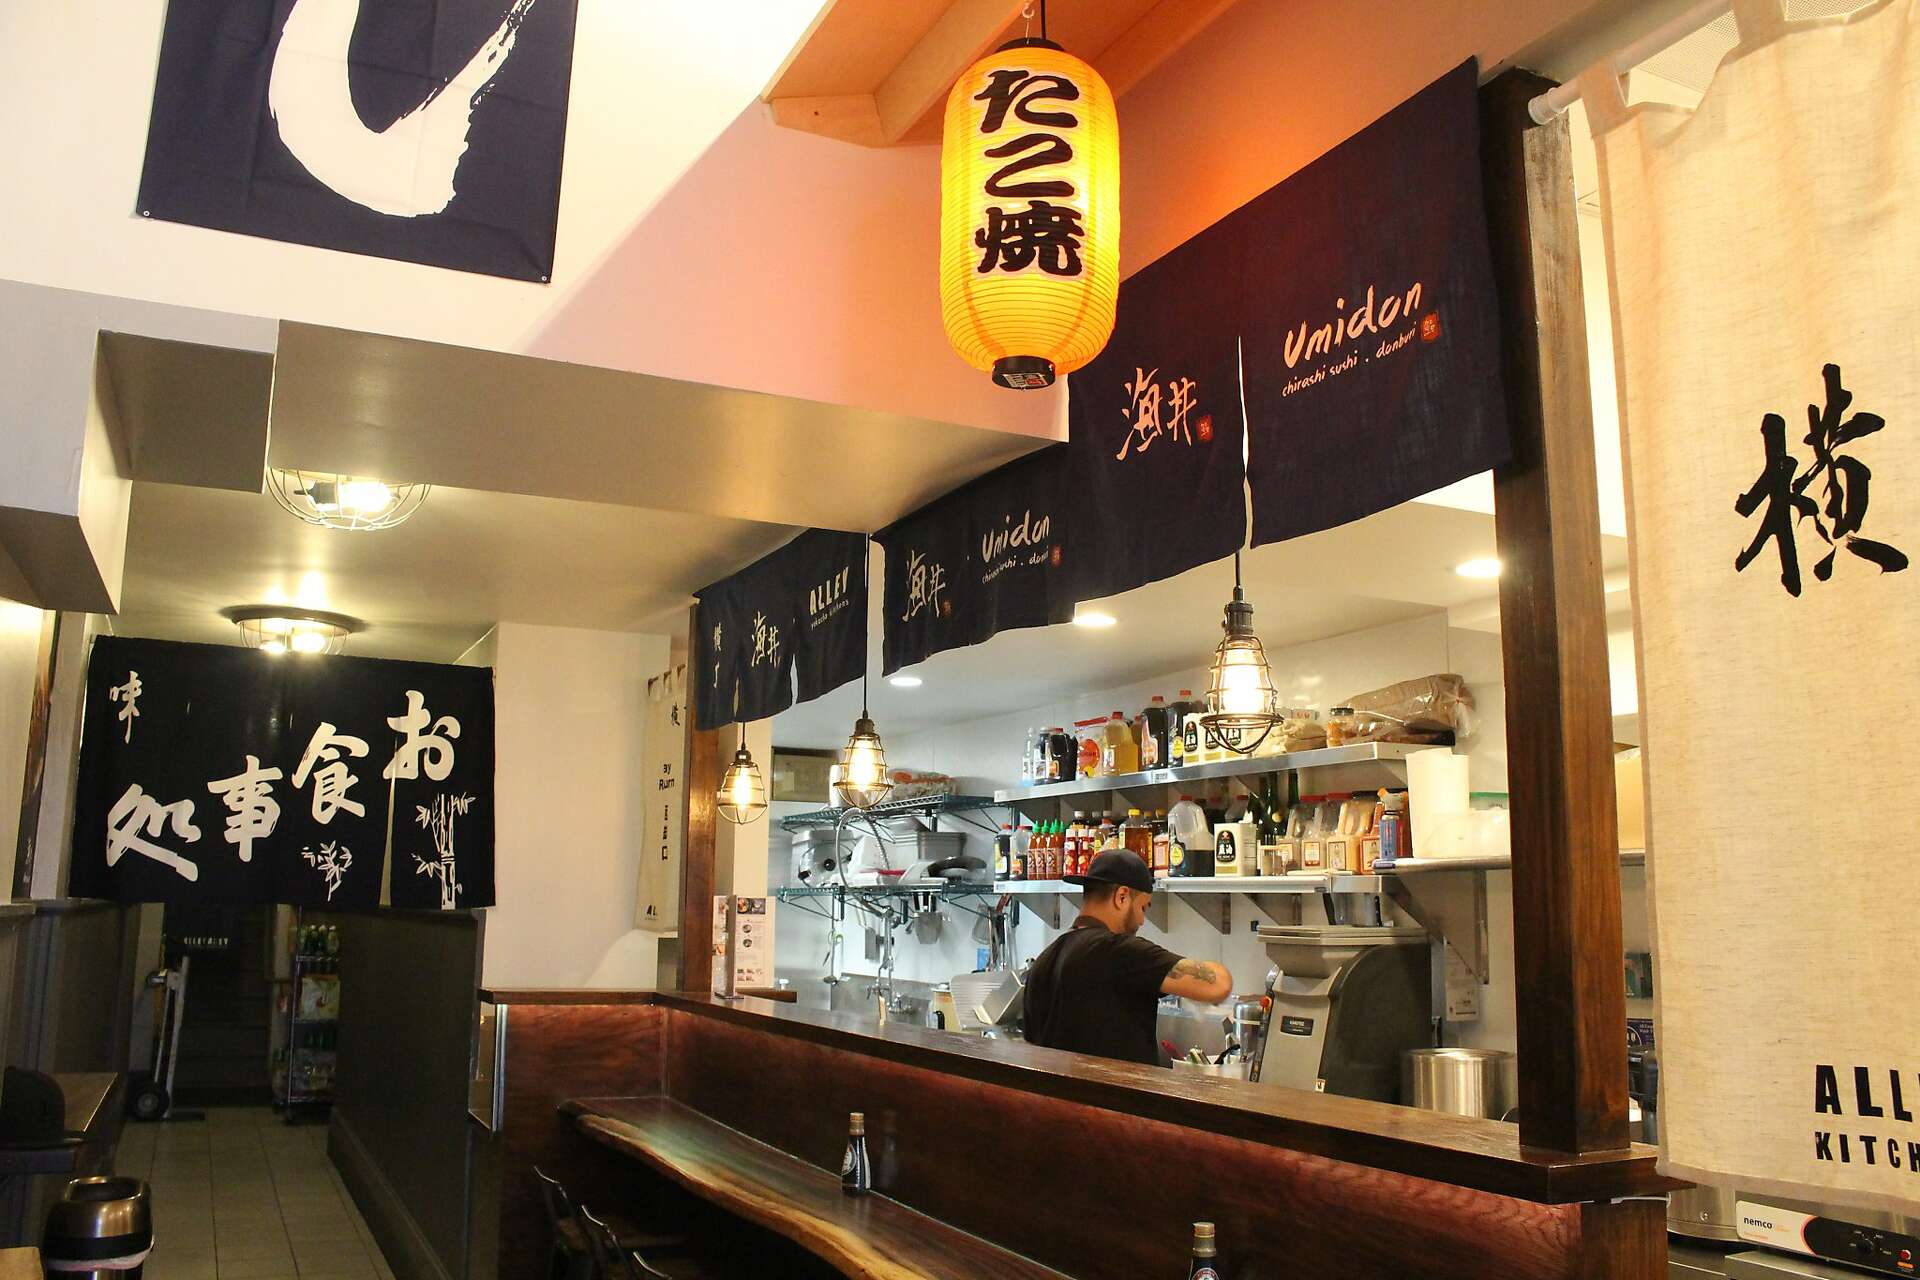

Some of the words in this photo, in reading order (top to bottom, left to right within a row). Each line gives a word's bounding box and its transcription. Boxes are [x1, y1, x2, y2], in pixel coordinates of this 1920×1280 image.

[1283, 282, 1422, 369] Umidon
[1282, 364, 1326, 397] chirashi
[1329, 349, 1358, 376] sushi
[1375, 321, 1417, 358] donburi
[809, 566, 849, 615] ALLEY
[1815, 1064, 1920, 1122] ALL
[1743, 1216, 1773, 1230] nemco
